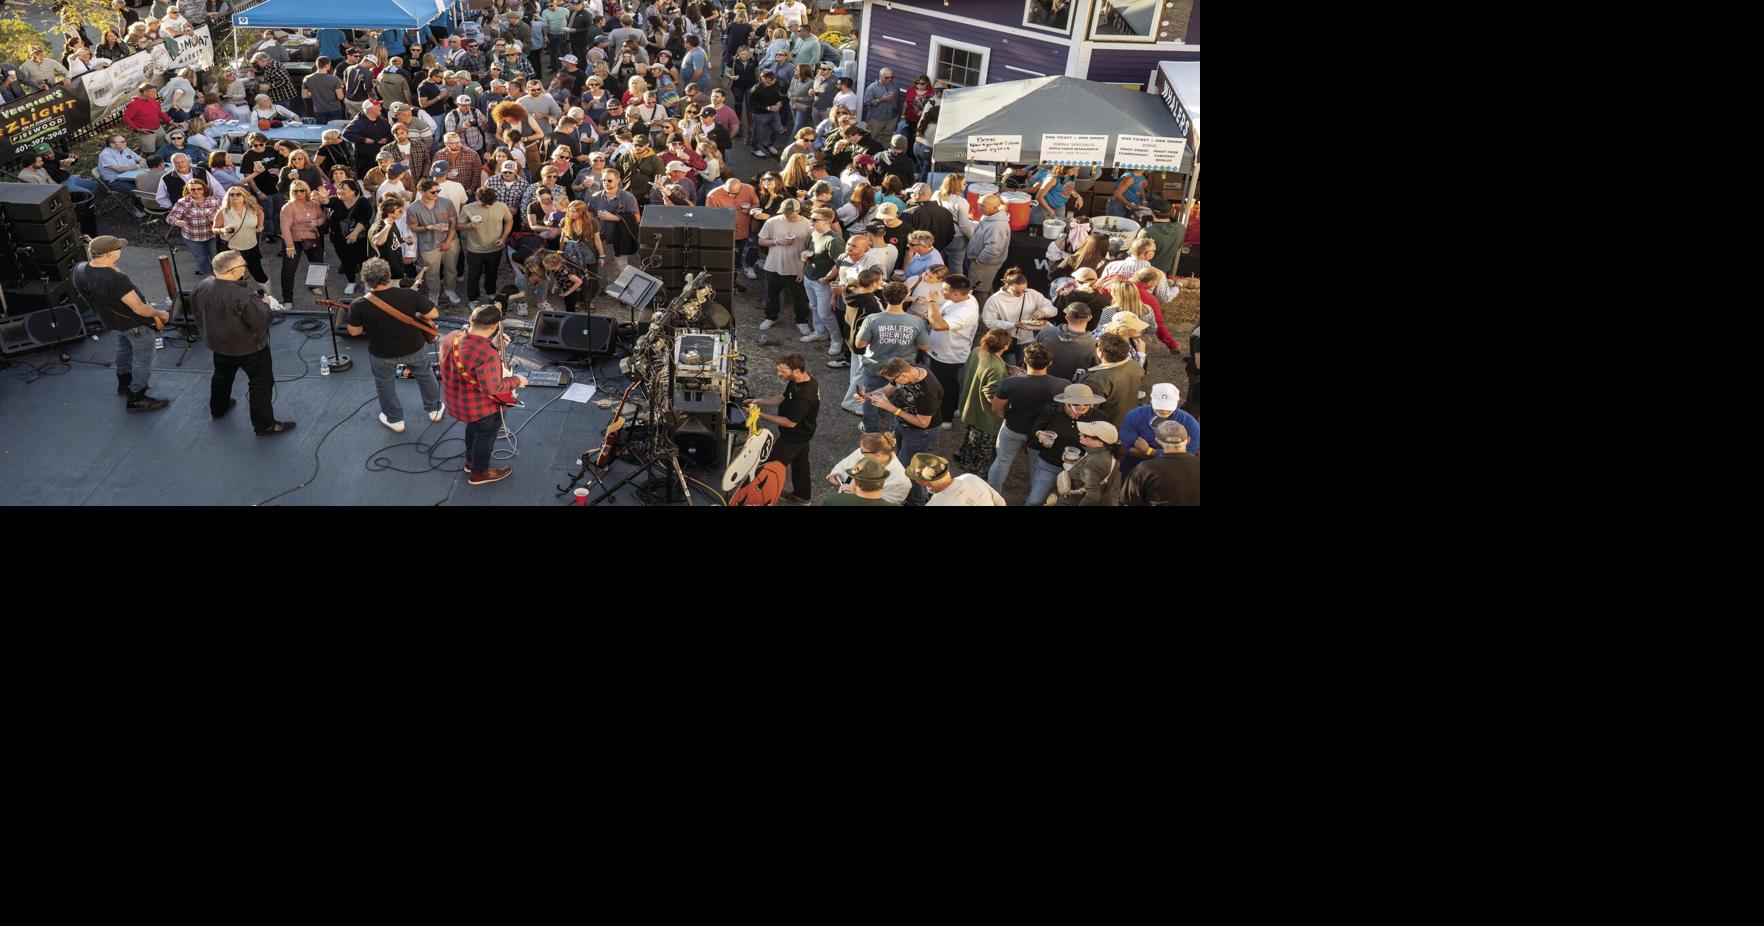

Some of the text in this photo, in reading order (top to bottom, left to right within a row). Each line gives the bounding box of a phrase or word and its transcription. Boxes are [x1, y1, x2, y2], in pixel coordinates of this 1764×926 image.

[178, 48, 203, 64] MARKET
[1162, 80, 1190, 137] WHALERS
[12, 118, 63, 142] FIREWOOD
[15, 127, 67, 153] 401-397-3942
[878, 325, 914, 333] WHALERS
[879, 331, 913, 340] BREWING
